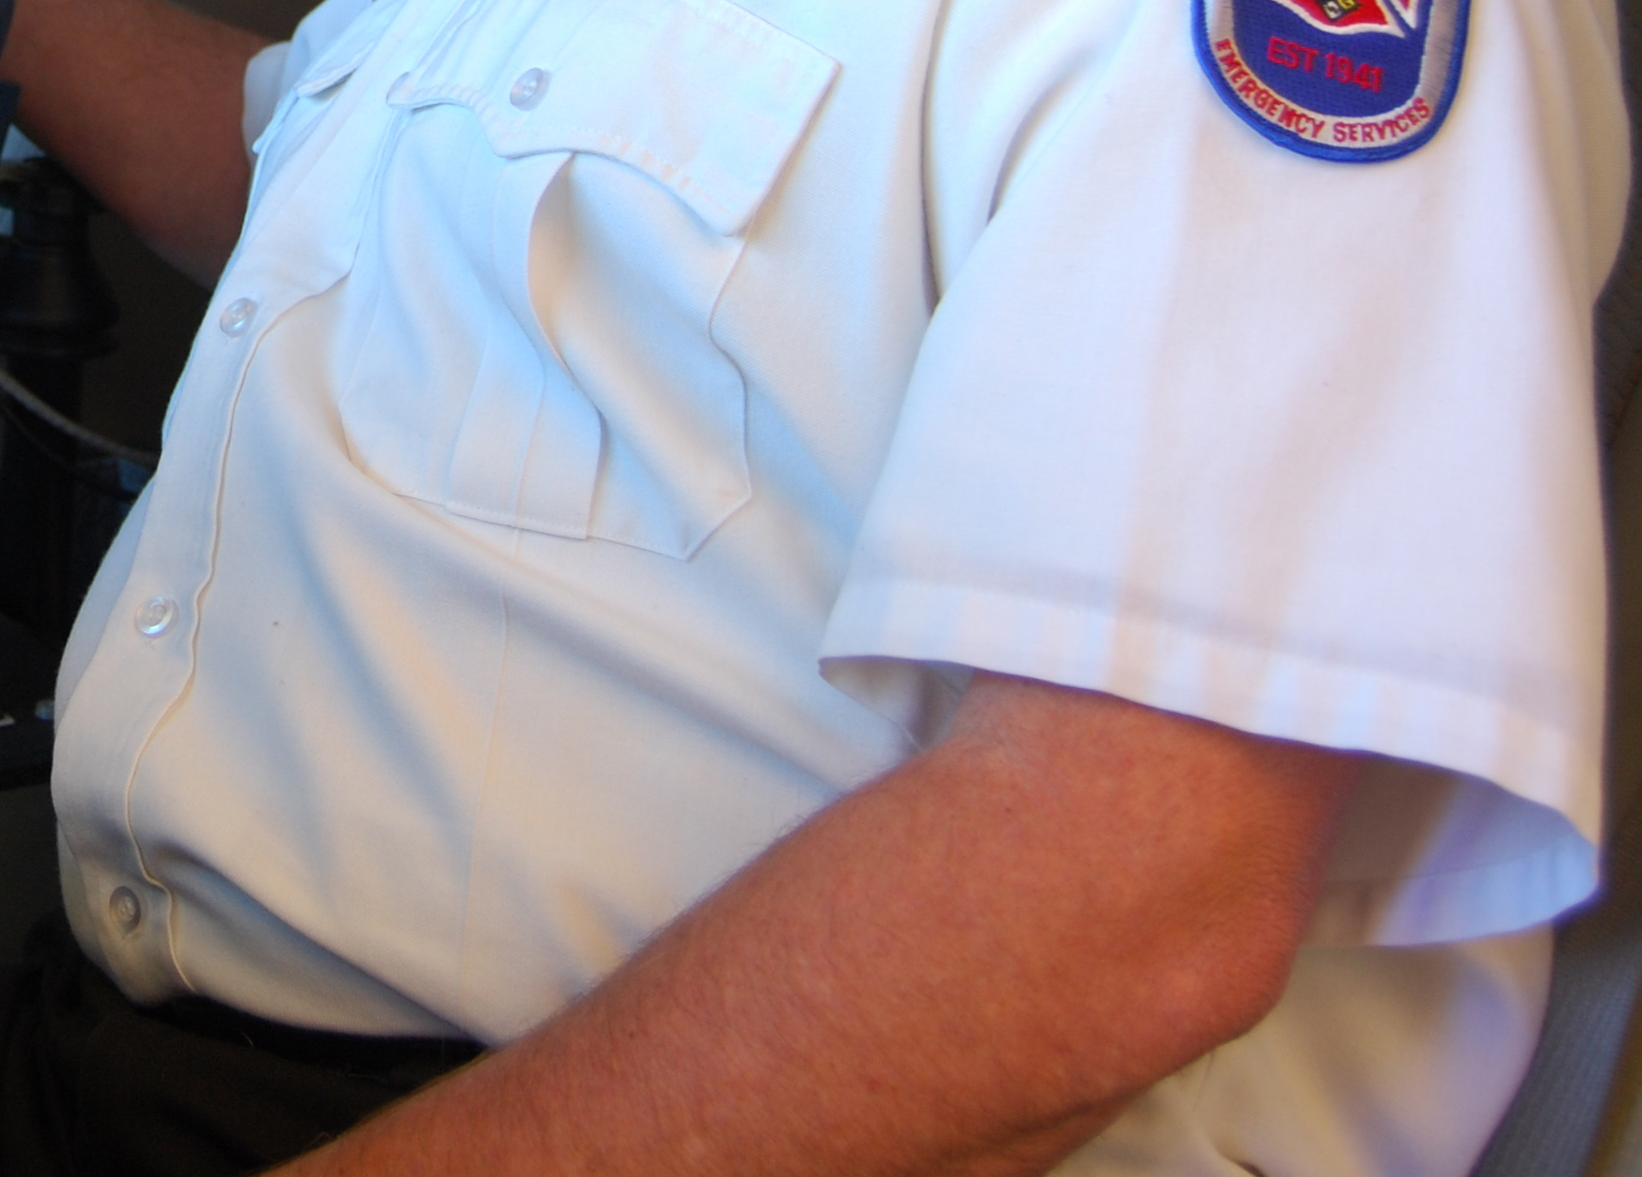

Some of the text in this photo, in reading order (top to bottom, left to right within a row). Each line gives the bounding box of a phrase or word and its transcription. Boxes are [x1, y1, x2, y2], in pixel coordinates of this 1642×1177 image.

[1215, 38, 1432, 143] EMERGENCY SERVICES
[1266, 35, 1384, 93] EST 1941
